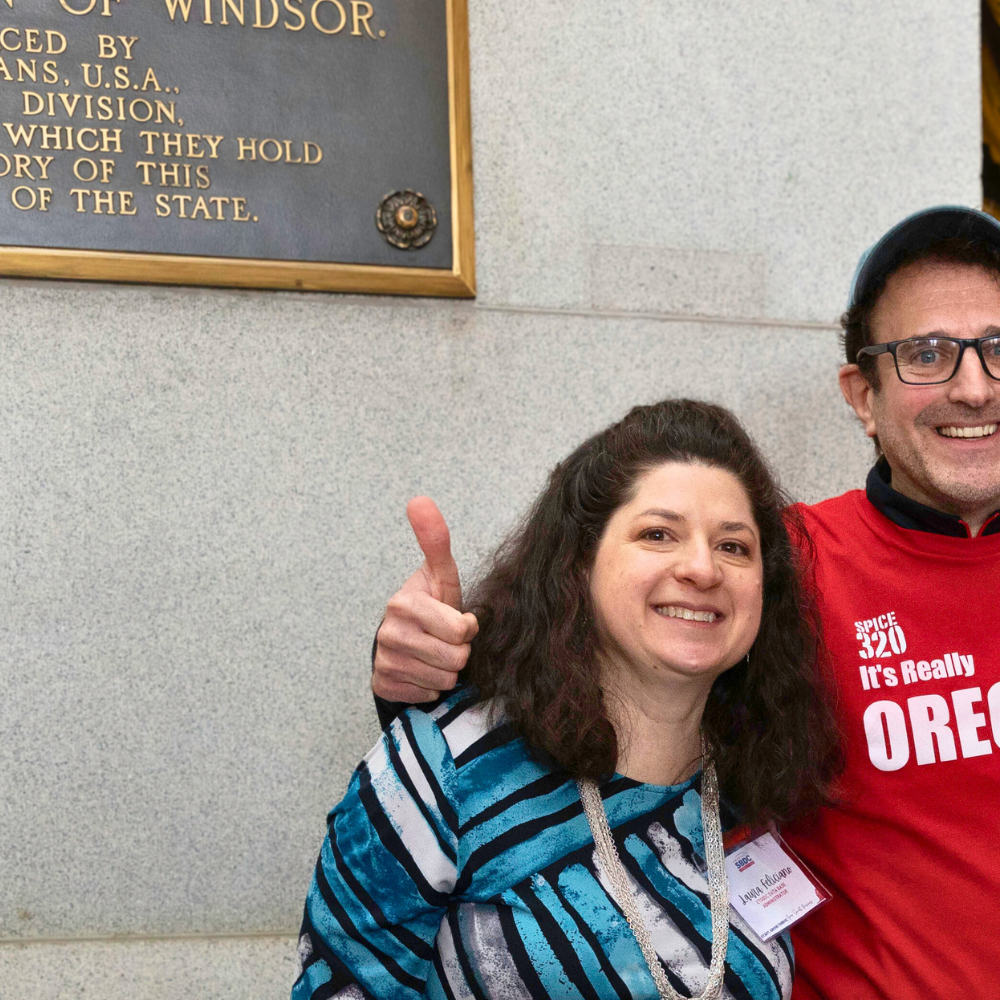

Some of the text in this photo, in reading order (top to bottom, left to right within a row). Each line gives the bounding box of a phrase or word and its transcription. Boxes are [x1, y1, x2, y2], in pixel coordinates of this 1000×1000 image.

[165, 0, 387, 40] WINDSOR.
[98, 34, 139, 60] BY
[81, 63, 180, 95] U.S.A.,
[22, 91, 184, 127] DIVISION,
[3, 122, 323, 164] WHICH THEY HOLD
[73, 157, 116, 184] OF
[135, 161, 211, 189] THIS
[11, 185, 259, 222] OF THE STATE.
[854, 611, 898, 634] SPICE
[856, 625, 907, 659] 320
[859, 652, 975, 691] It's Really
[734, 854, 752, 869] SBDC
